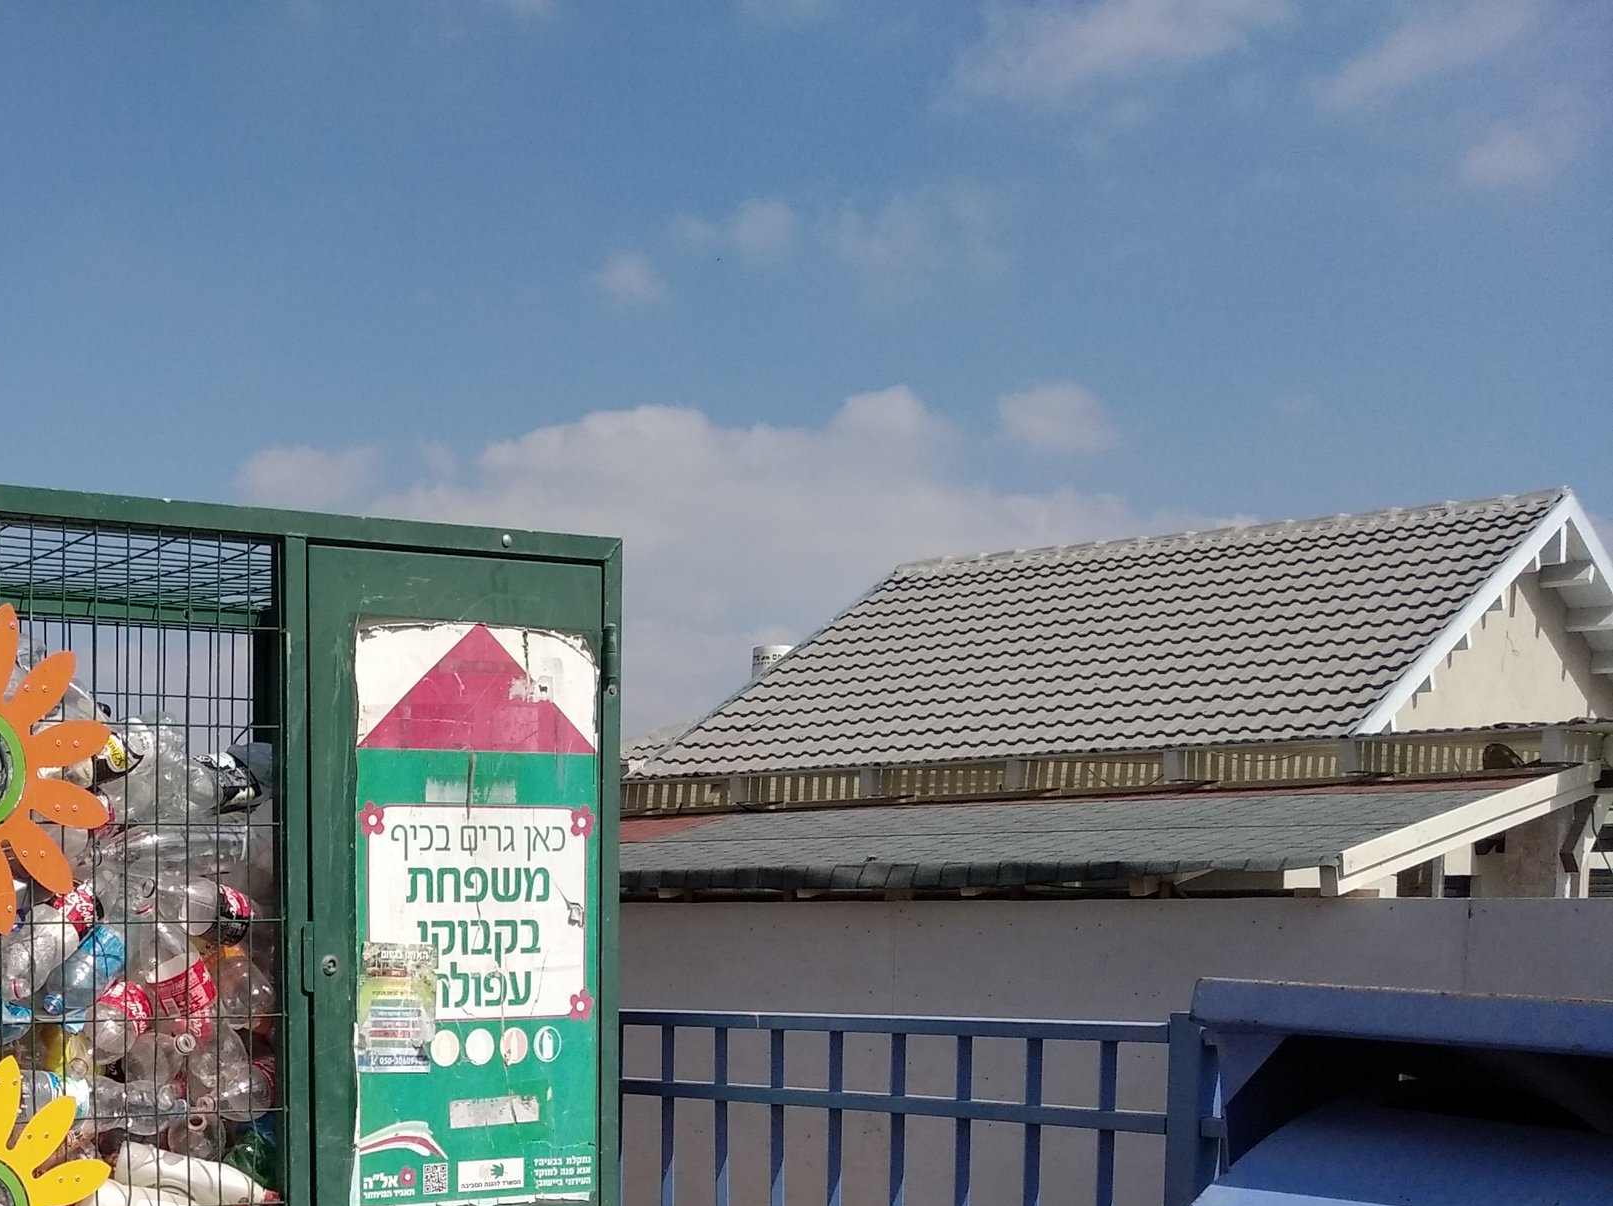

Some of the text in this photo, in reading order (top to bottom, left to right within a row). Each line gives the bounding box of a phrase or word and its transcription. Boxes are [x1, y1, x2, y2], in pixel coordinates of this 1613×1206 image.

[391, 824, 566, 861] כאן גרים בכיף
[406, 866, 550, 903] משפחת
[417, 919, 541, 969] בקבוקי
